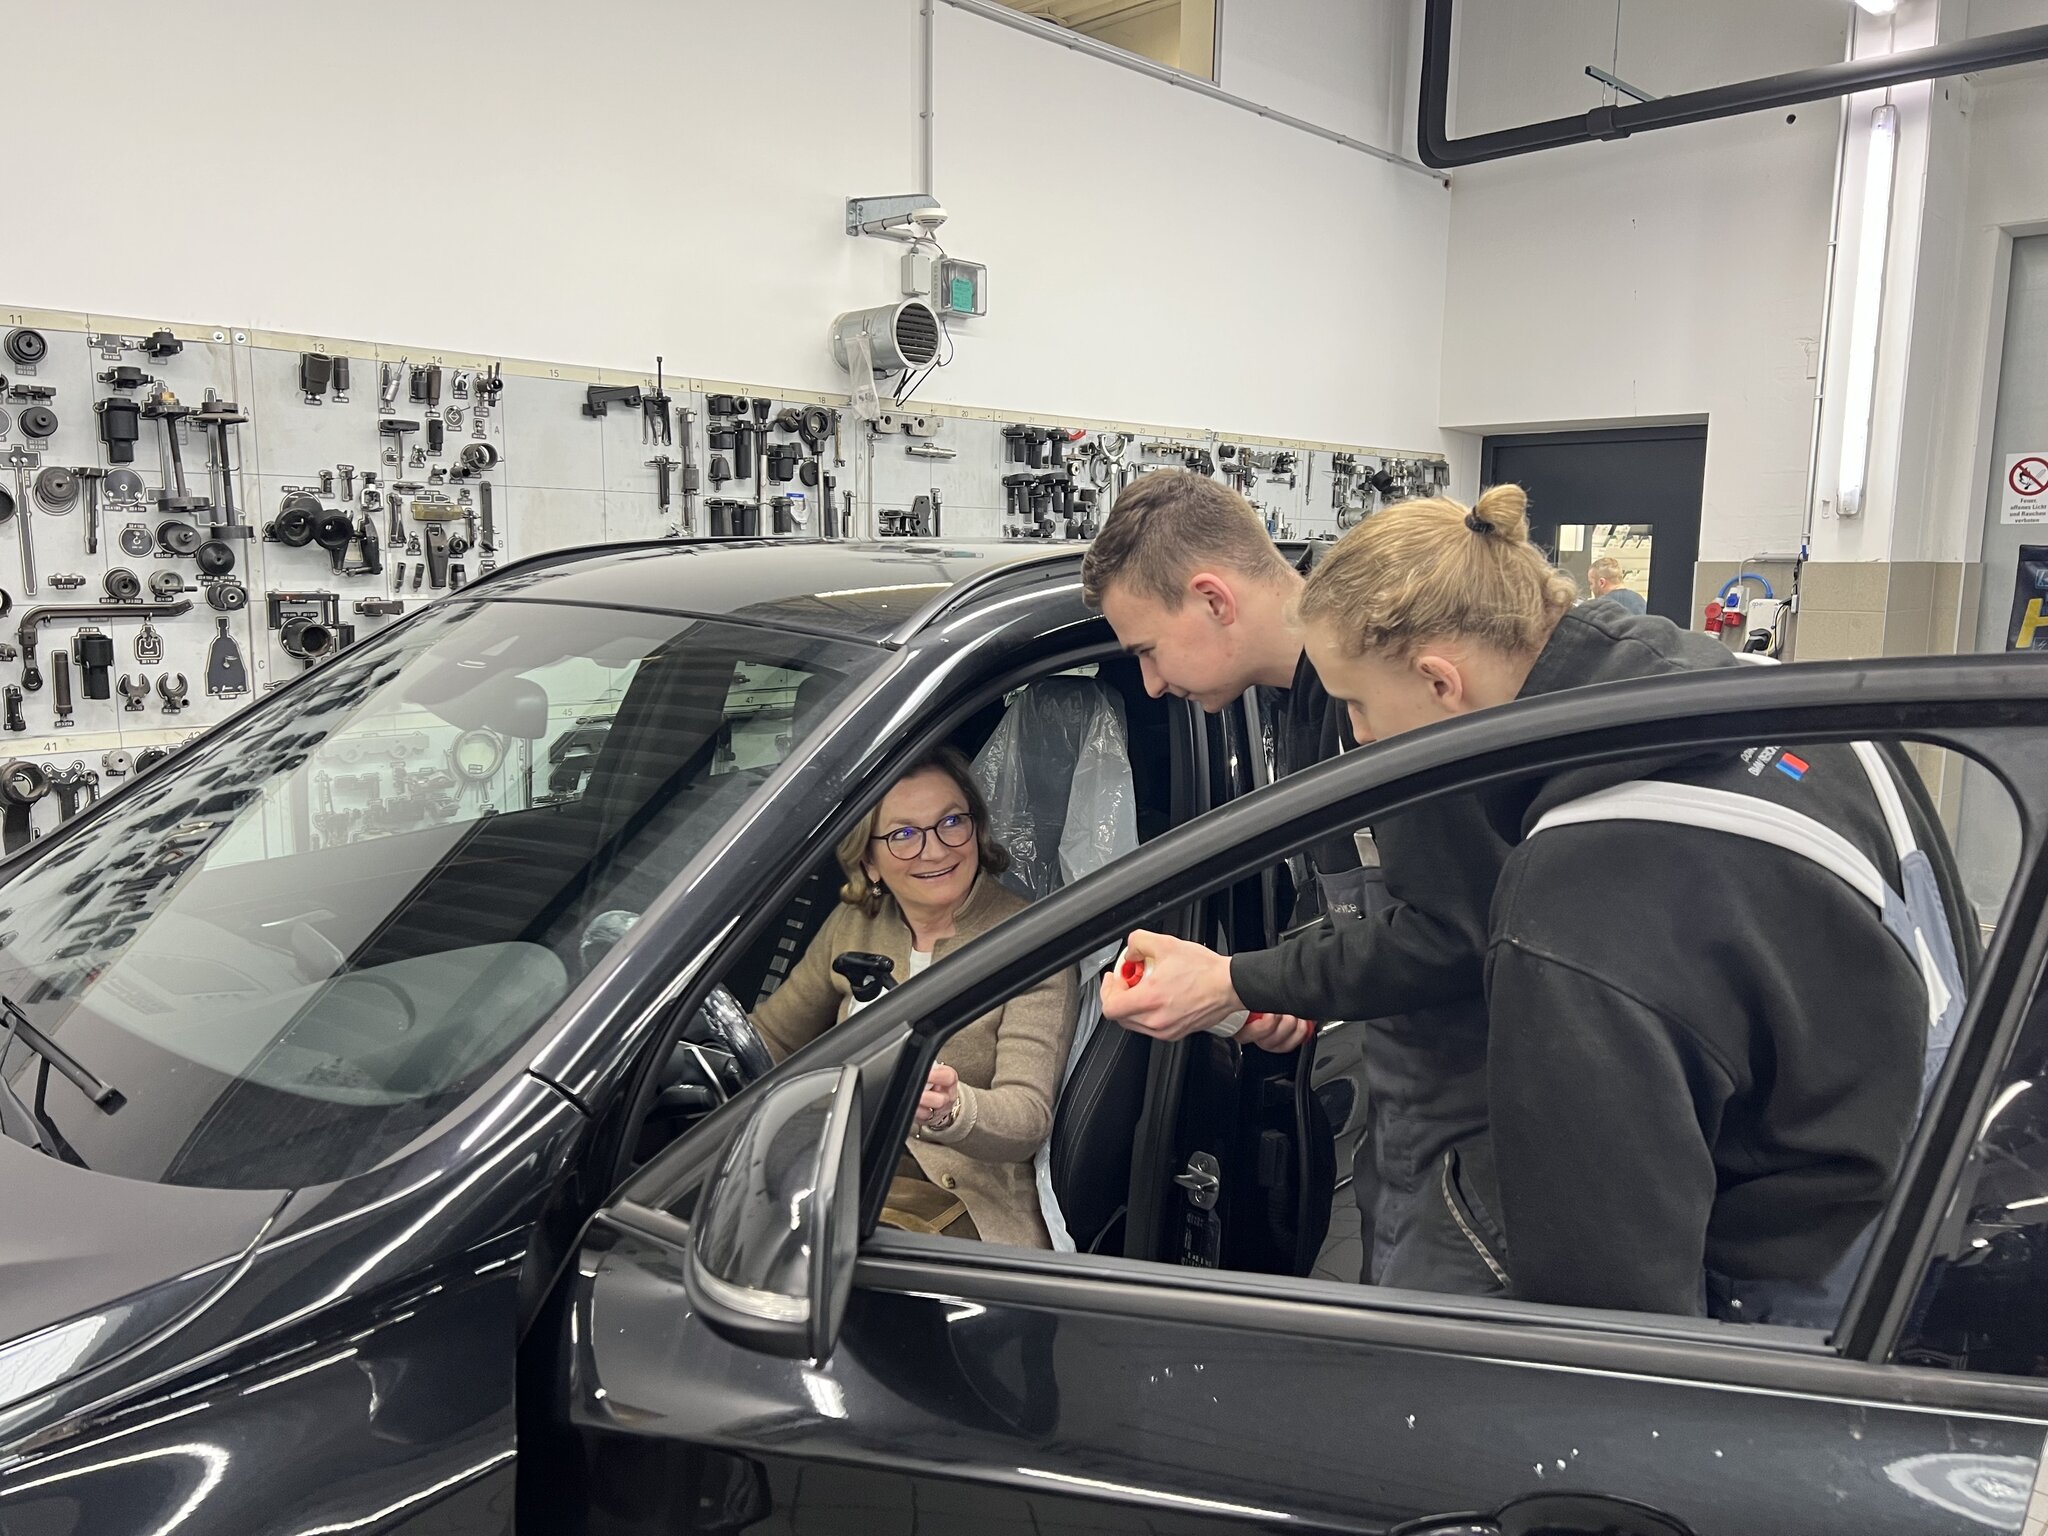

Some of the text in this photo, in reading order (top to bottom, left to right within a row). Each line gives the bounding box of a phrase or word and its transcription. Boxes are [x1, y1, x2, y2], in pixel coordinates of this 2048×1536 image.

[9, 314, 23, 325] 11
[312, 343, 325, 353] 13
[431, 355, 443, 365] 14
[549, 369, 560, 378] 15
[643, 379, 653, 387] 16
[740, 387, 749, 395] 17
[818, 396, 826, 404] 18
[243, 406, 250, 416] A
[494, 425, 500, 435] A
[498, 540, 504, 548] B
[258, 660, 265, 669] C
[562, 708, 573, 716] 45
[43, 742, 58, 751] 41
